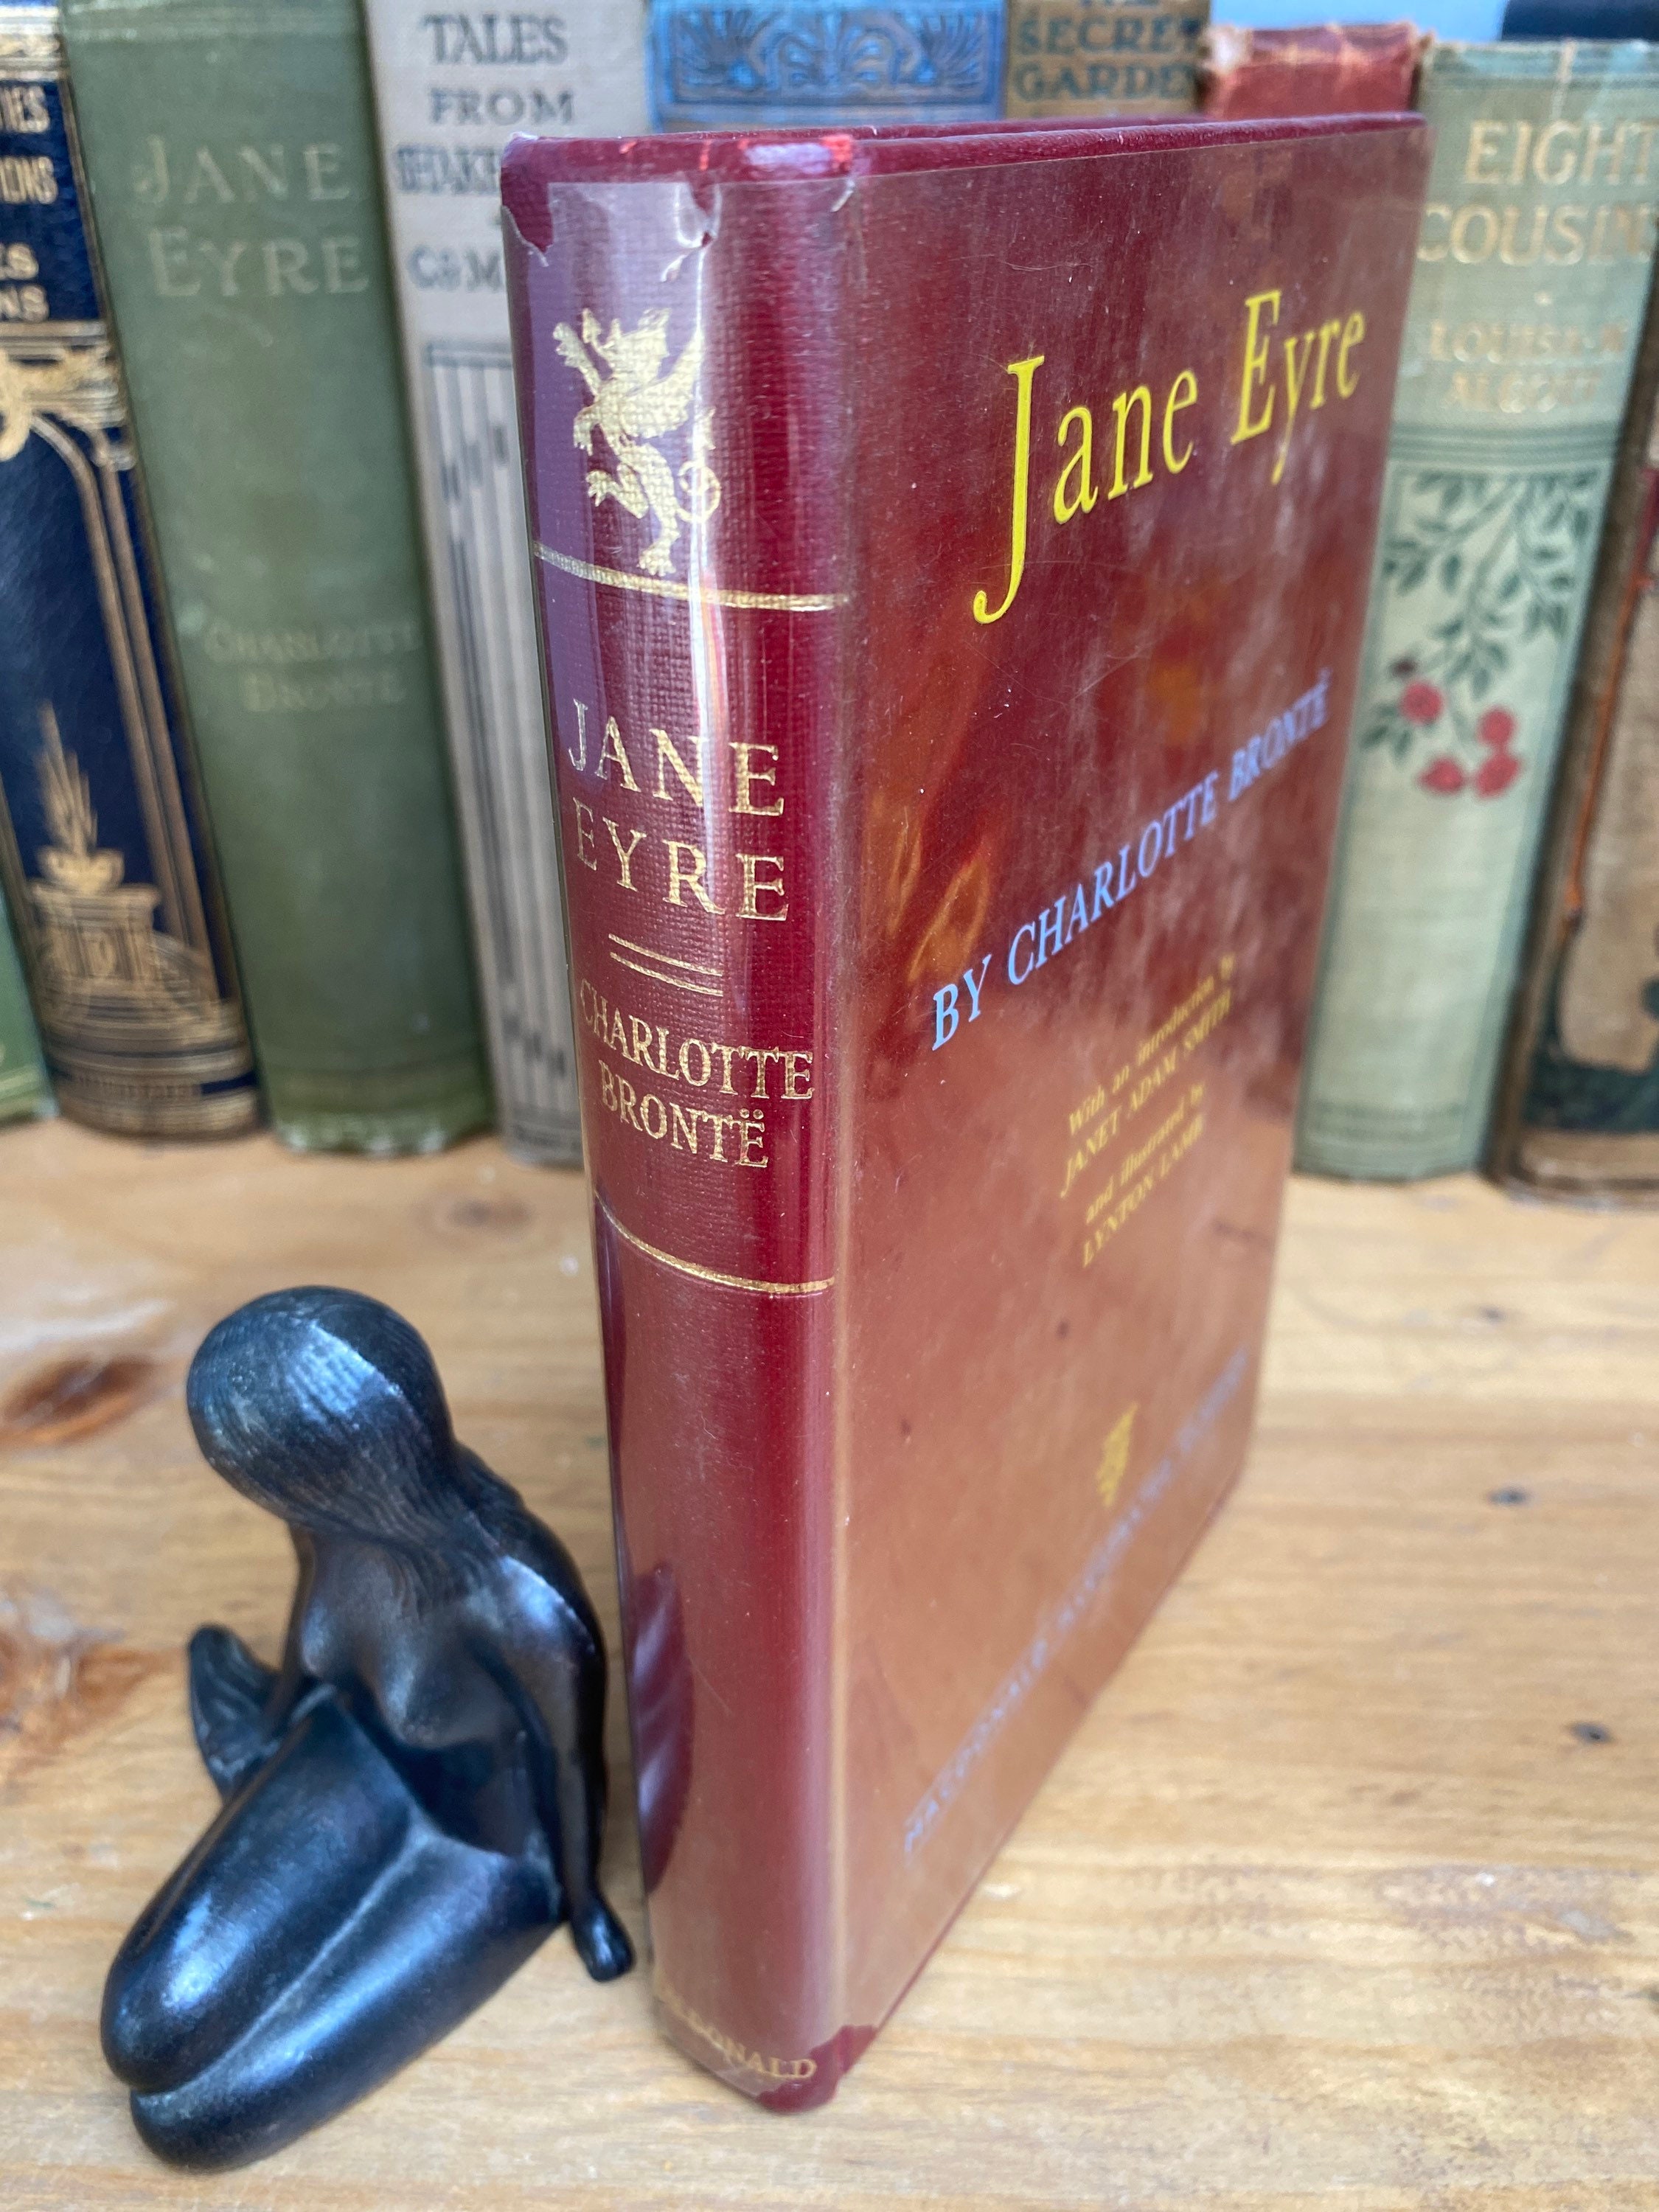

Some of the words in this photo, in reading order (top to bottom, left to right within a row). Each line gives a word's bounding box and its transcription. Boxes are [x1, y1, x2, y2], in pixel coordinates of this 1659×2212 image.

[419, 13, 569, 66] TALES
[427, 86, 577, 126] FROM
[1015, 62, 1196, 102] GARDE
[131, 134, 351, 205] JANE
[1464, 118, 1659, 185] EIGHT
[149, 225, 369, 296] EYRE
[1416, 201, 1655, 265] COUSIN
[973, 354, 1198, 625] Jane
[1231, 290, 1366, 485] Eyre
[567, 698, 785, 816] JANE
[572, 797, 789, 921] EYRE
[932, 954, 992, 1051] BY
[1007, 771, 1219, 986] CHARLOTTE
[580, 978, 813, 1099] CHARLOTTE
[598, 1060, 769, 1168] BRONTË
